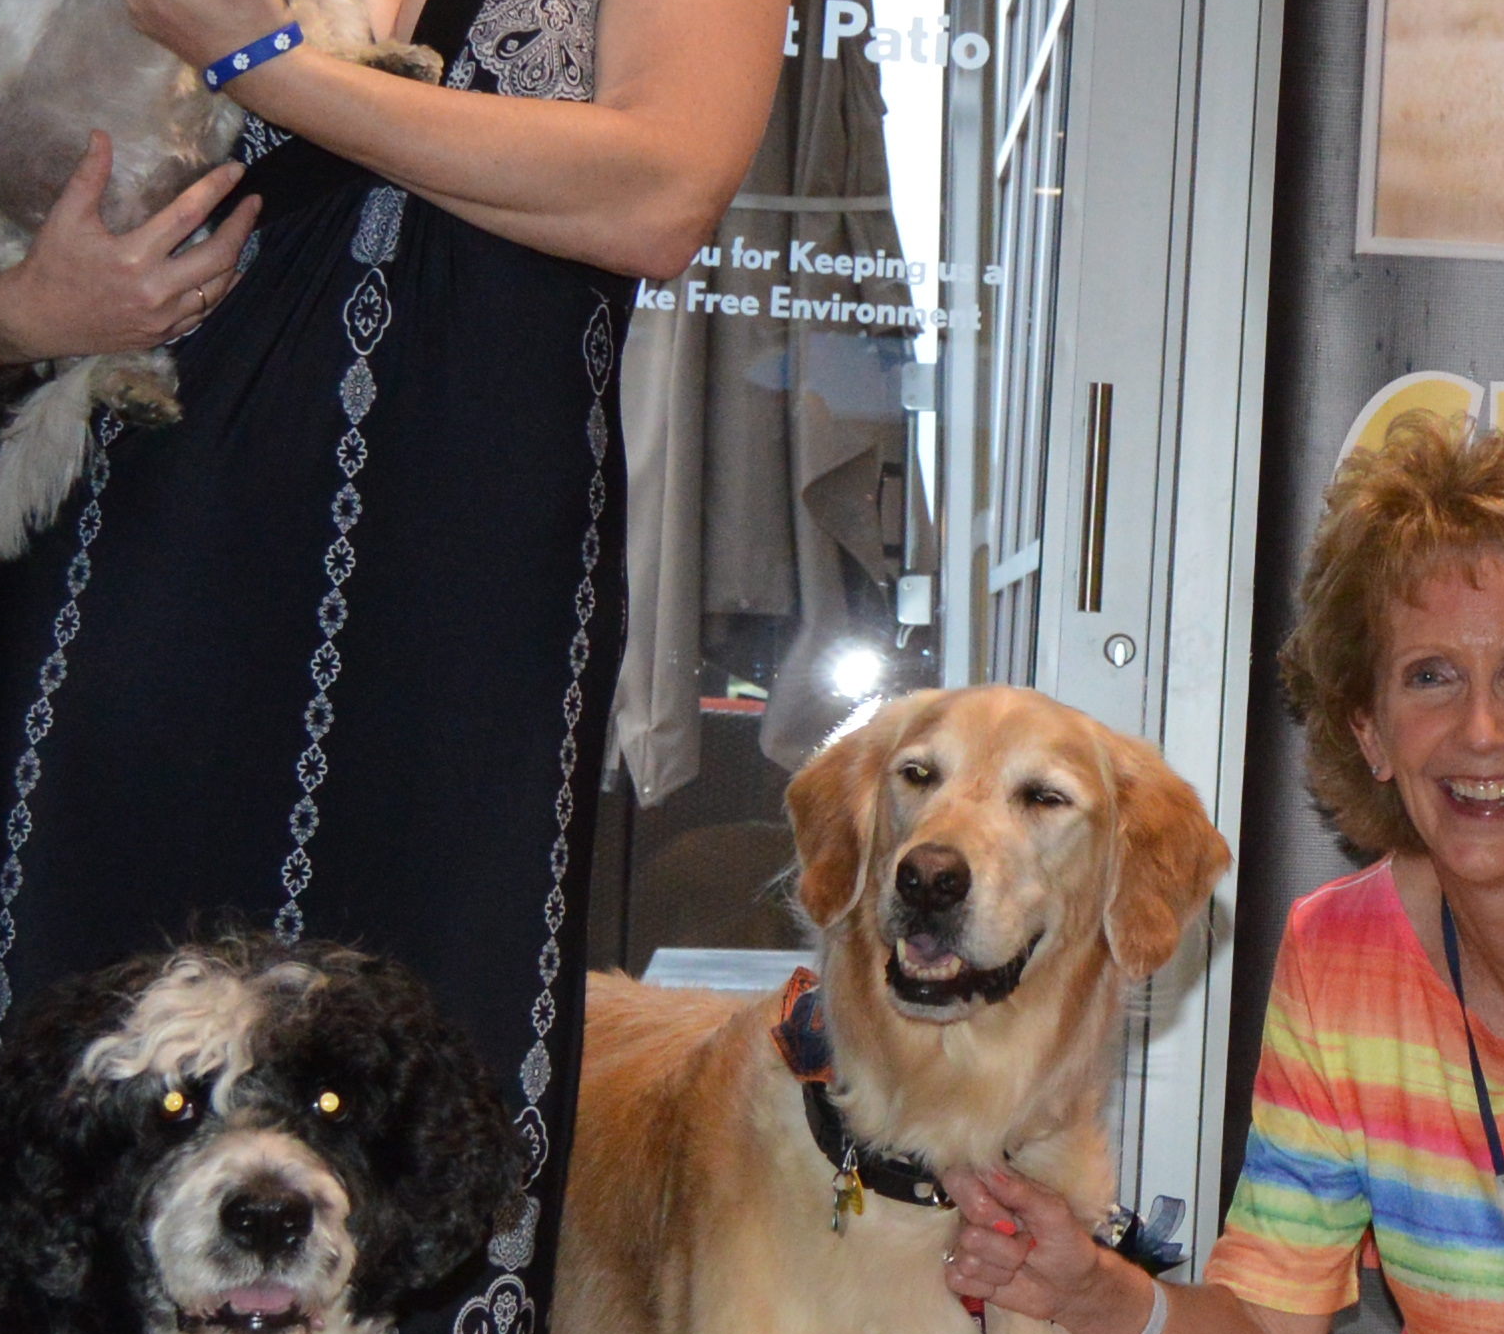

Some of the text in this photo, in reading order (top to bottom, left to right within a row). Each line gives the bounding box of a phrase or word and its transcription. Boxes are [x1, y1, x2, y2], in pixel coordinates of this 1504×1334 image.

[731, 236, 780, 270] for
[790, 240, 926, 285] Keeping
[983, 264, 1004, 285] a
[687, 281, 760, 316] Free
[770, 285, 982, 331] Environment
